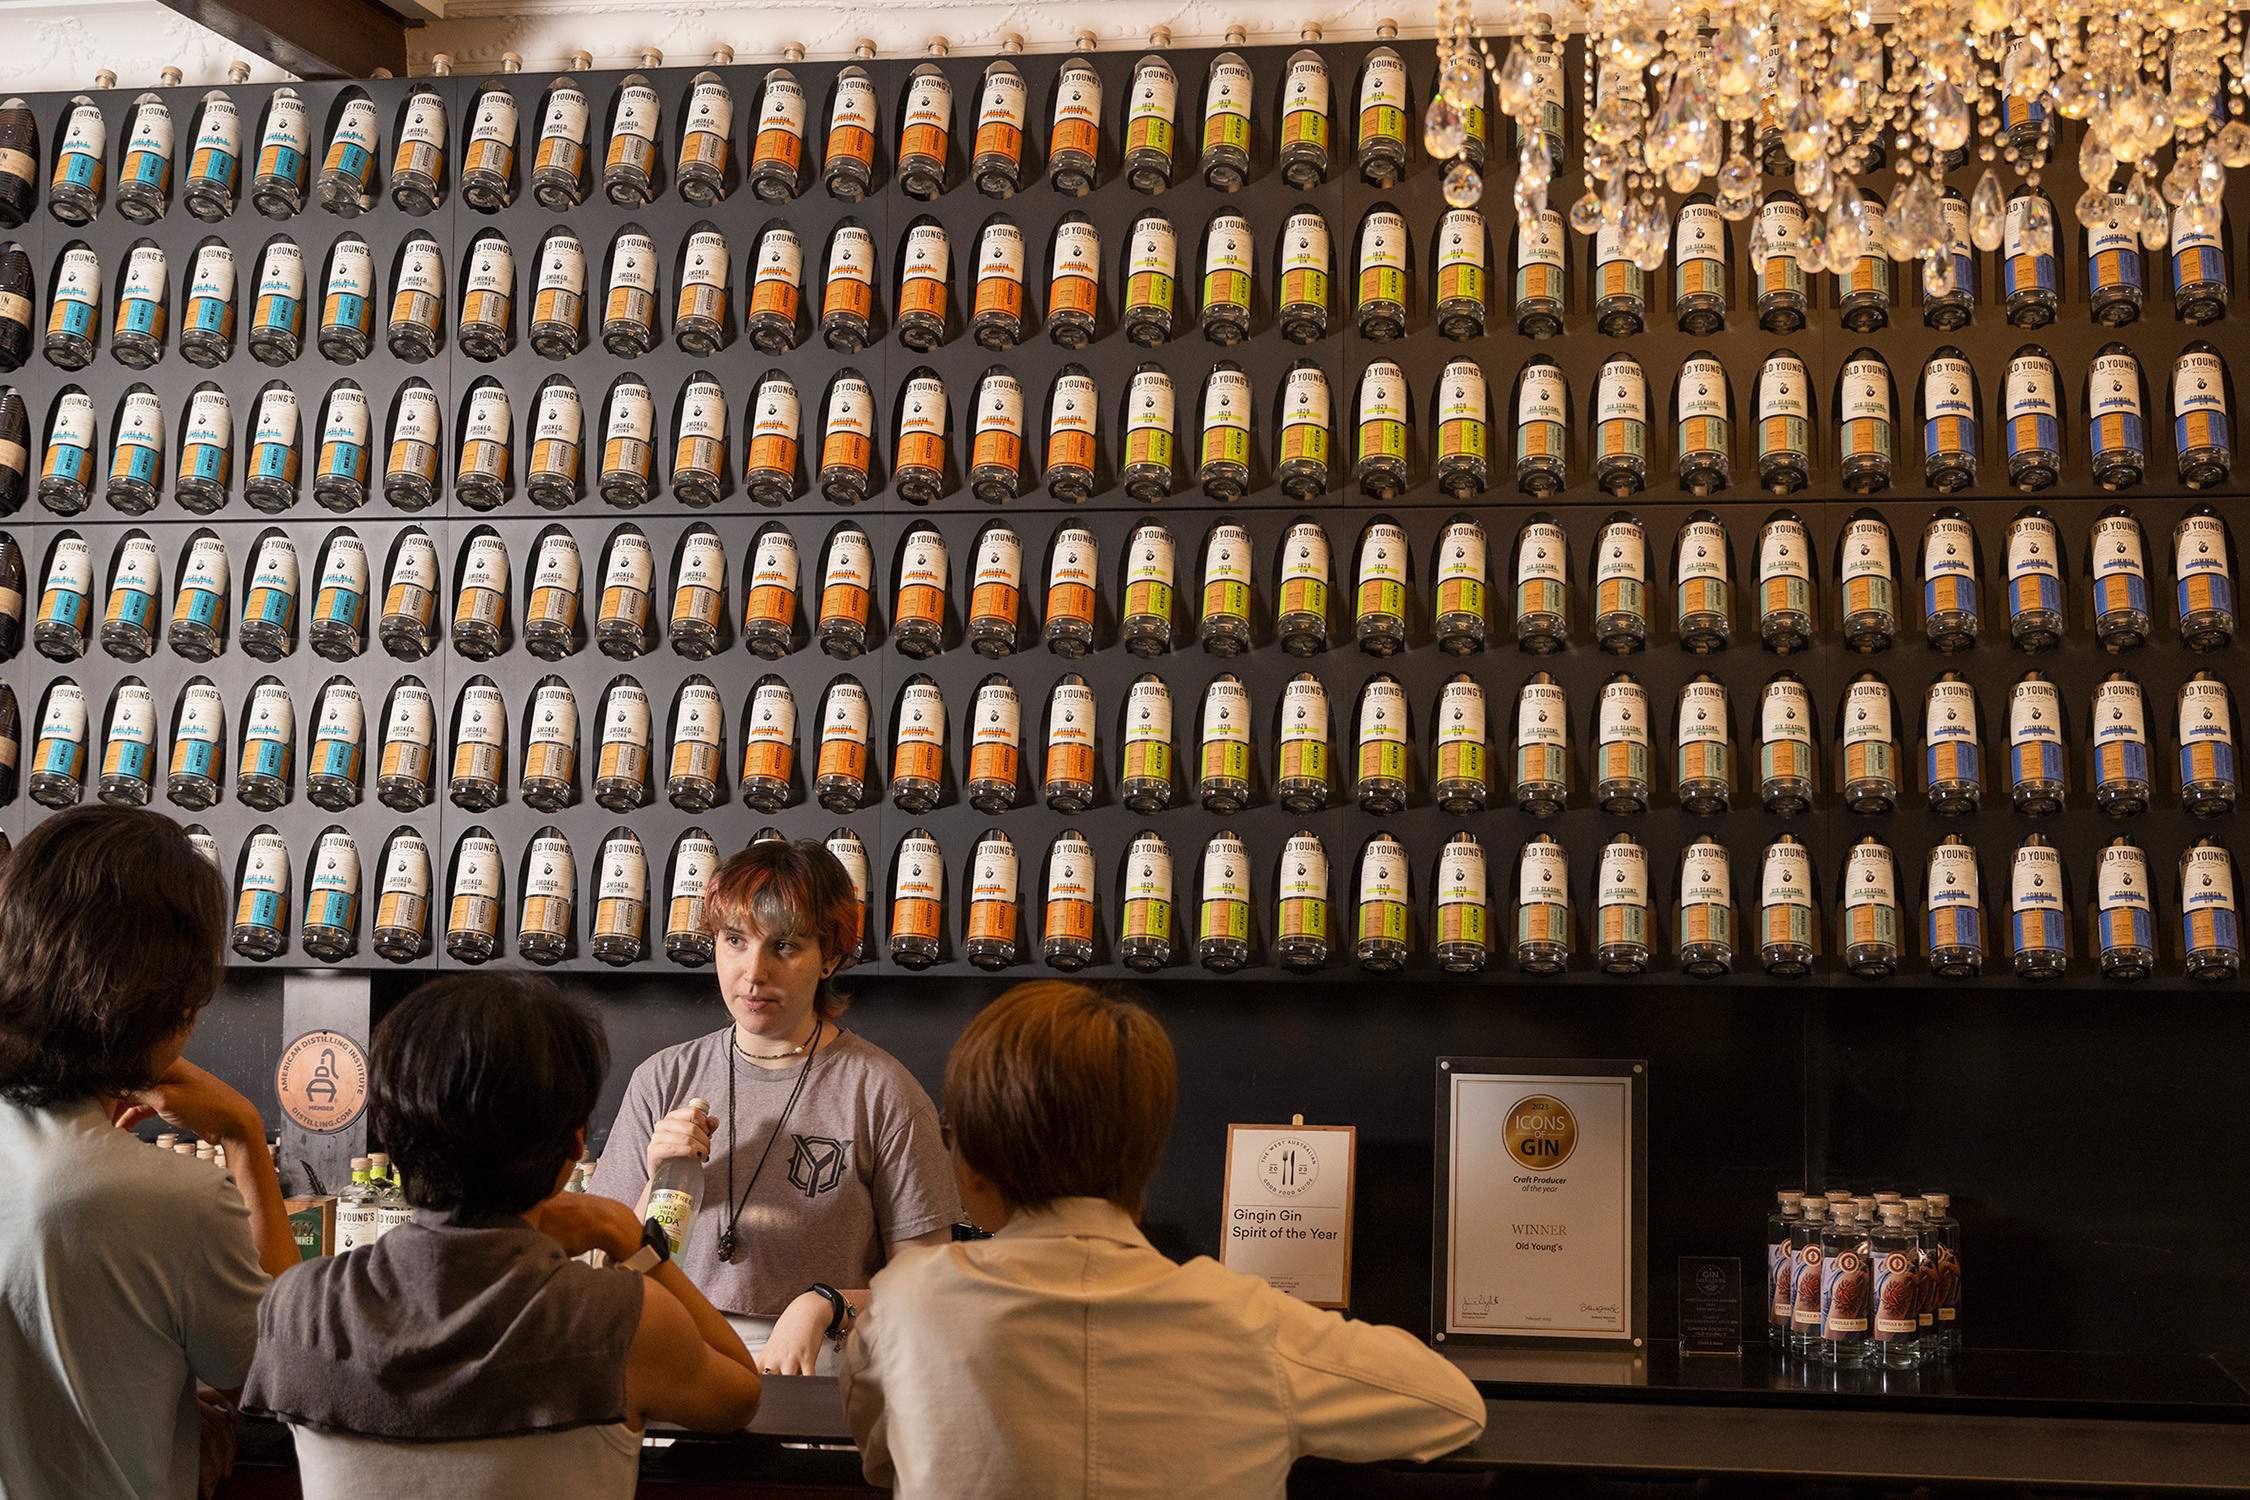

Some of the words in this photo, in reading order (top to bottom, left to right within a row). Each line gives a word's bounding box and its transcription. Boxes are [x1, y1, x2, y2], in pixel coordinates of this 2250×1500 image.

[618, 271, 641, 281] SMOKED
[536, 726, 560, 734] SMOKED
[535, 878, 559, 886] SMOKED
[281, 1046, 302, 1092] AMERICAN
[301, 1036, 350, 1051] DISTILLING
[348, 1048, 366, 1095] INSTITUTE
[291, 1106, 353, 1128] DISTILLING.COM
[1515, 1115, 1566, 1131] ICONS
[1534, 1130, 1546, 1138] OF
[1260, 1151, 1270, 1163] THE
[1268, 1140, 1285, 1152] WEST
[1287, 1140, 1316, 1165] AUSTRALIAN
[1521, 1139, 1560, 1157] GIN
[1513, 1175, 1532, 1184] Craft
[1533, 1176, 1567, 1185] Producer
[1278, 1188, 1296, 1196] FOOD
[1297, 1177, 1314, 1193] GUIDE
[1542, 1186, 1558, 1194] year
[343, 1212, 375, 1222] YOUNG'S
[656, 1215, 681, 1227] ODA
[1233, 1208, 1276, 1224] Gingin
[1280, 1209, 1302, 1222] Gin
[1232, 1226, 1267, 1240] Spirit
[1270, 1227, 1285, 1239] of
[1286, 1227, 1307, 1240] the
[1310, 1228, 1338, 1240] Year
[1512, 1223, 1568, 1236] WINNER
[1515, 1242, 1530, 1251] Old
[1531, 1242, 1563, 1253] Young's
